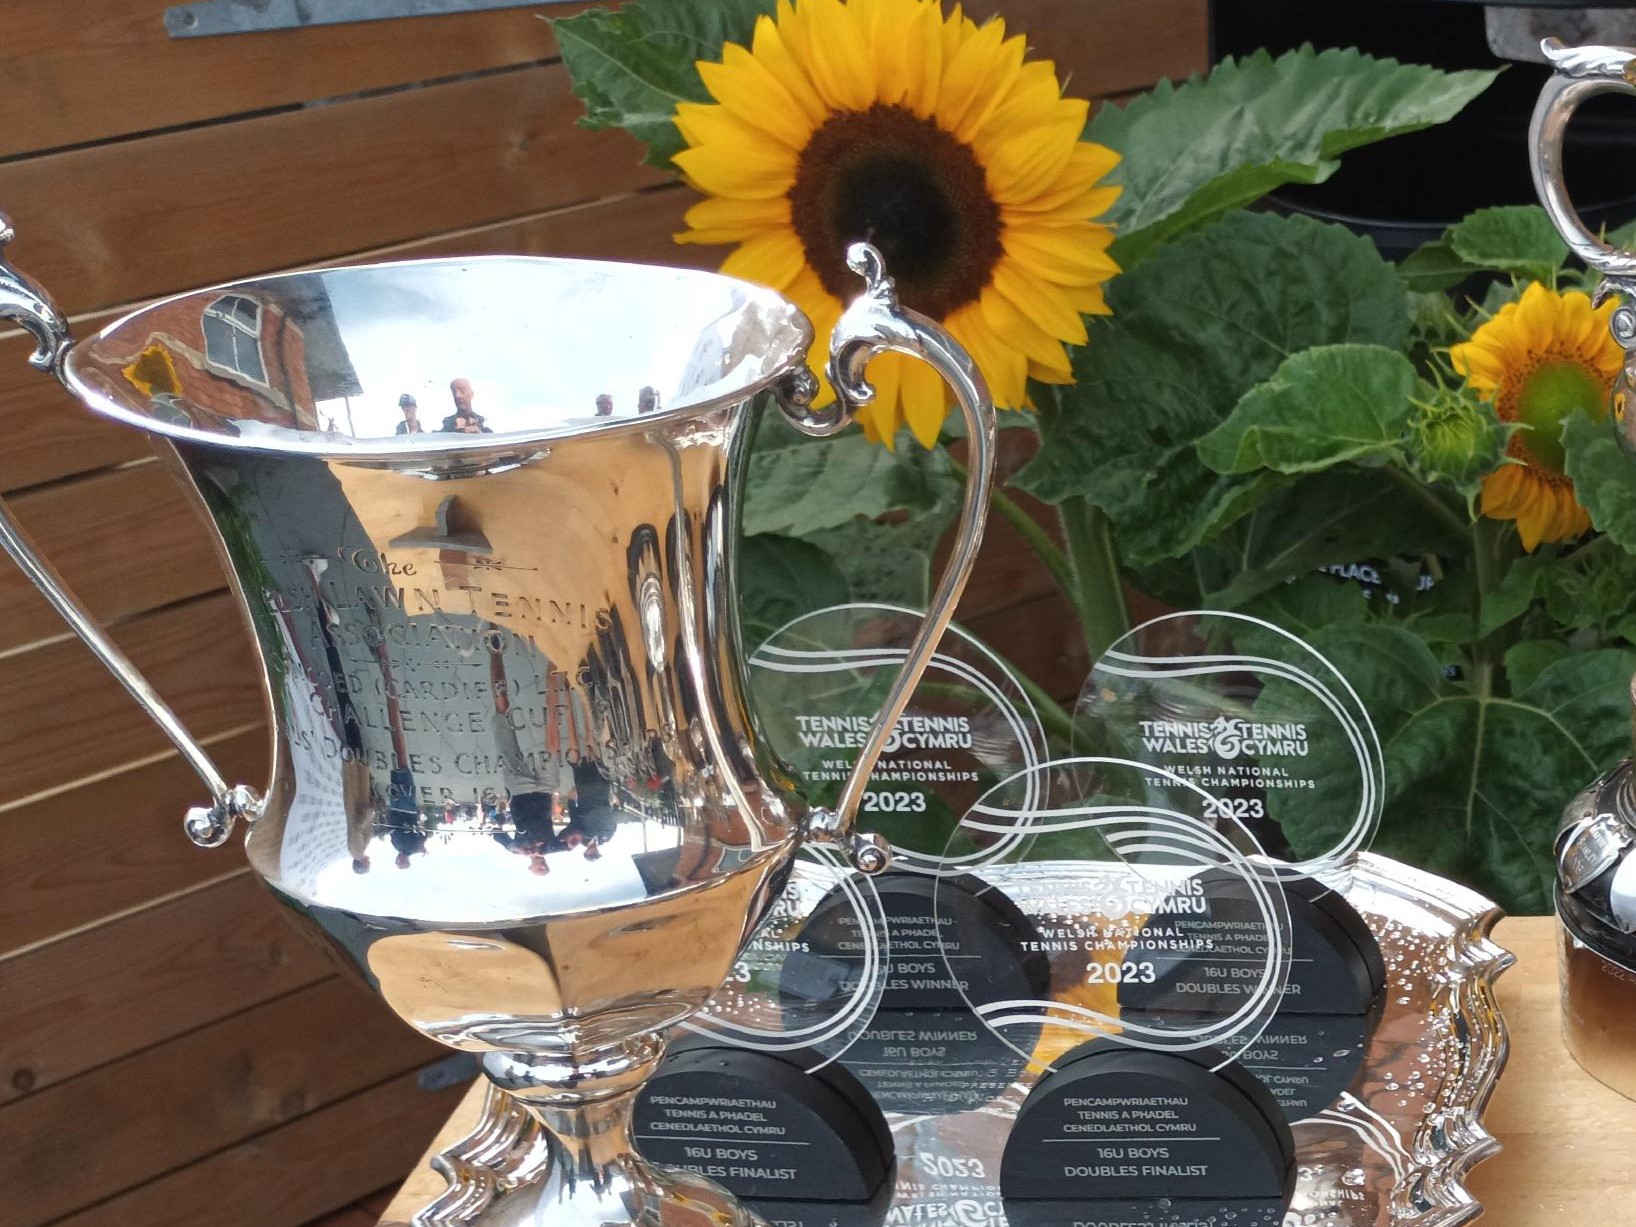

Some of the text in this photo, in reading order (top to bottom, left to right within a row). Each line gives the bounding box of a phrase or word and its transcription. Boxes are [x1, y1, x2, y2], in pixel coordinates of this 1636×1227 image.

[458, 586, 613, 631] TENNIS
[795, 716, 970, 733] TENNIS TENNIS
[1138, 720, 1307, 740] TENNIS TENNIS
[799, 733, 972, 749] WALES CYMRU
[1141, 737, 1309, 757] WALES CYMRU
[878, 759, 952, 770] NATIONAL
[1163, 765, 1289, 777] WELSH NATIONAL
[1201, 778, 1316, 789] CHAMPIONSHIPS
[863, 791, 926, 812] 2023
[1202, 798, 1264, 819] 2023
[1102, 927, 1184, 938] NATIONAL
[1020, 939, 1214, 952] TENNIS CHAMPIONSHIPS
[897, 963, 936, 974] BOYS
[1086, 961, 1156, 984] 2023
[1204, 966, 1227, 978] 16U
[910, 980, 969, 991] WINNER
[1176, 982, 1241, 994] DOUBLES
[650, 1095, 777, 1109] PENCAMPWRIAETHAU
[1063, 1097, 1189, 1107] PENCAMPWRIAETHAU
[719, 1110, 768, 1122] PHADEL
[1078, 1110, 1180, 1120] TENNIS PHADEL
[744, 1125, 786, 1136] CYMRU
[1063, 1123, 1197, 1133] CENEDLAETHOL CYMRU
[684, 1146, 759, 1162] 16U BOYS
[1097, 1147, 1169, 1159] 16U BOYS
[729, 1165, 798, 1180] FINALIST
[1064, 1165, 1208, 1177] DOUBLES FINALIST
